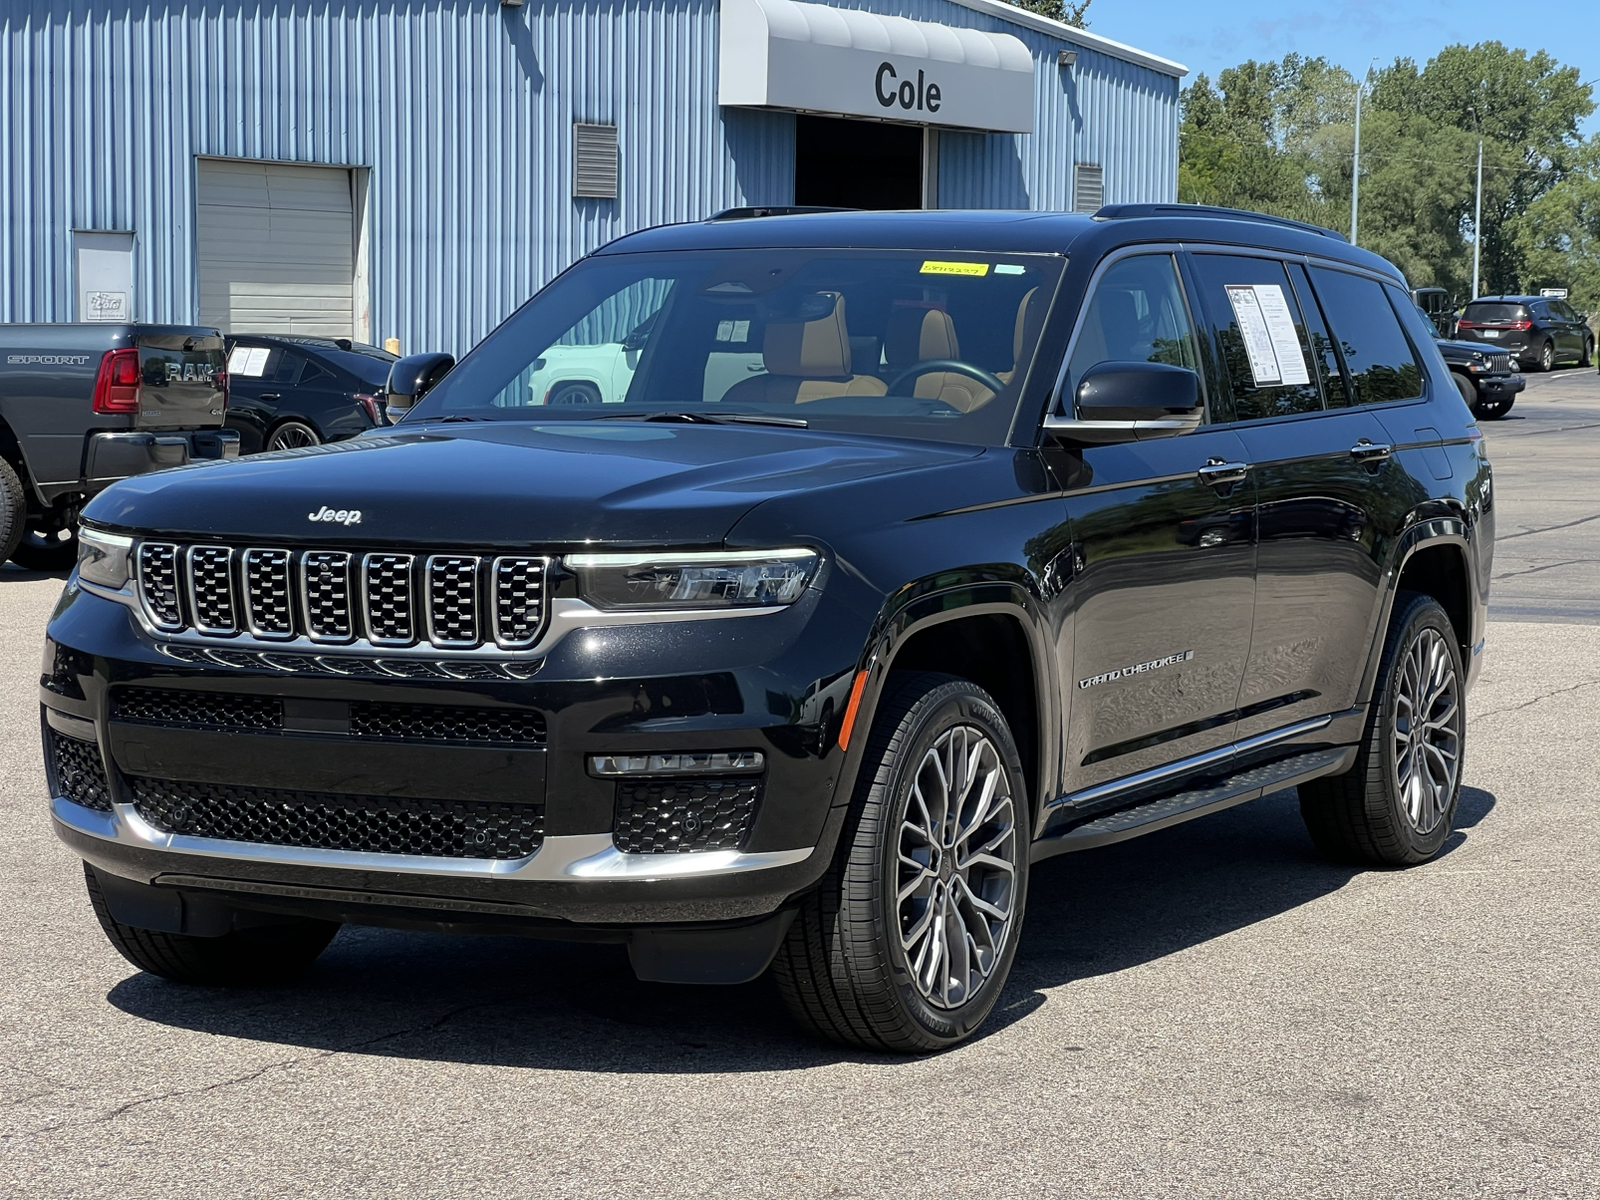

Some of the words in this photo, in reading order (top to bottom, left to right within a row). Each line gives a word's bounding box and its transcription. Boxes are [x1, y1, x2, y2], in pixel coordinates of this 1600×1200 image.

[875, 61, 941, 113] Cole
[7, 355, 90, 365] SPORT
[165, 362, 214, 382] RAM
[308, 505, 361, 526] Jeep
[1079, 670, 1121, 689] GRAND
[1121, 653, 1185, 677] CHEROKEE
